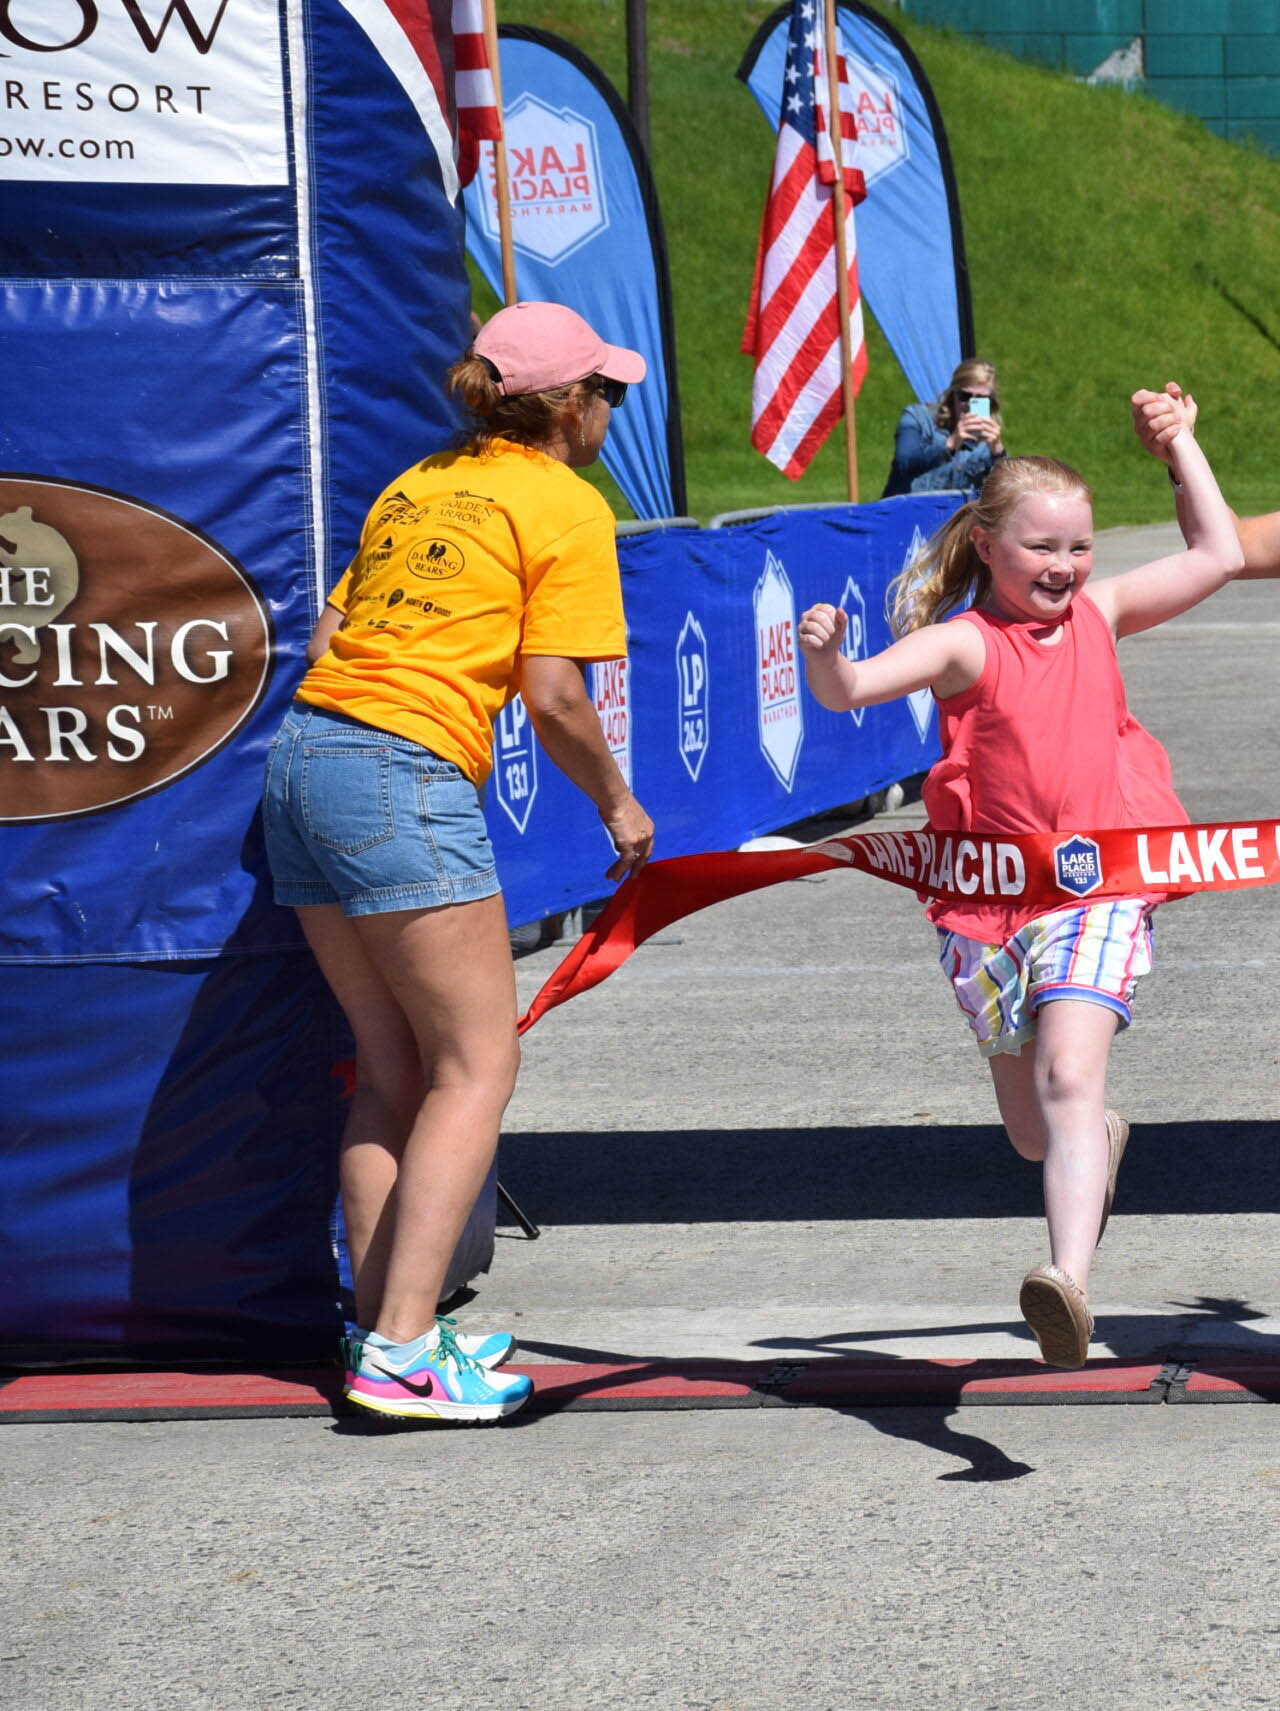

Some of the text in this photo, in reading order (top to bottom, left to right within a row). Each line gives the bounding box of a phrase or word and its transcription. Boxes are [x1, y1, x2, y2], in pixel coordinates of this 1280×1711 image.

[0, 0, 229, 57] OW
[5, 80, 211, 114] RESORT
[0, 137, 135, 160] ow.com
[0, 619, 233, 688] CING
[760, 620, 793, 670] LAKE
[597, 660, 627, 711] LAKE
[682, 653, 704, 707] LP
[762, 665, 795, 702] PLACID
[500, 697, 527, 749] LP
[602, 711, 627, 746] ACID
[850, 832, 1026, 897] LAKE PLACID
[1061, 853, 1095, 865] LAKE
[1062, 863, 1095, 873] PLACID
[1137, 827, 1266, 884] LAKE
